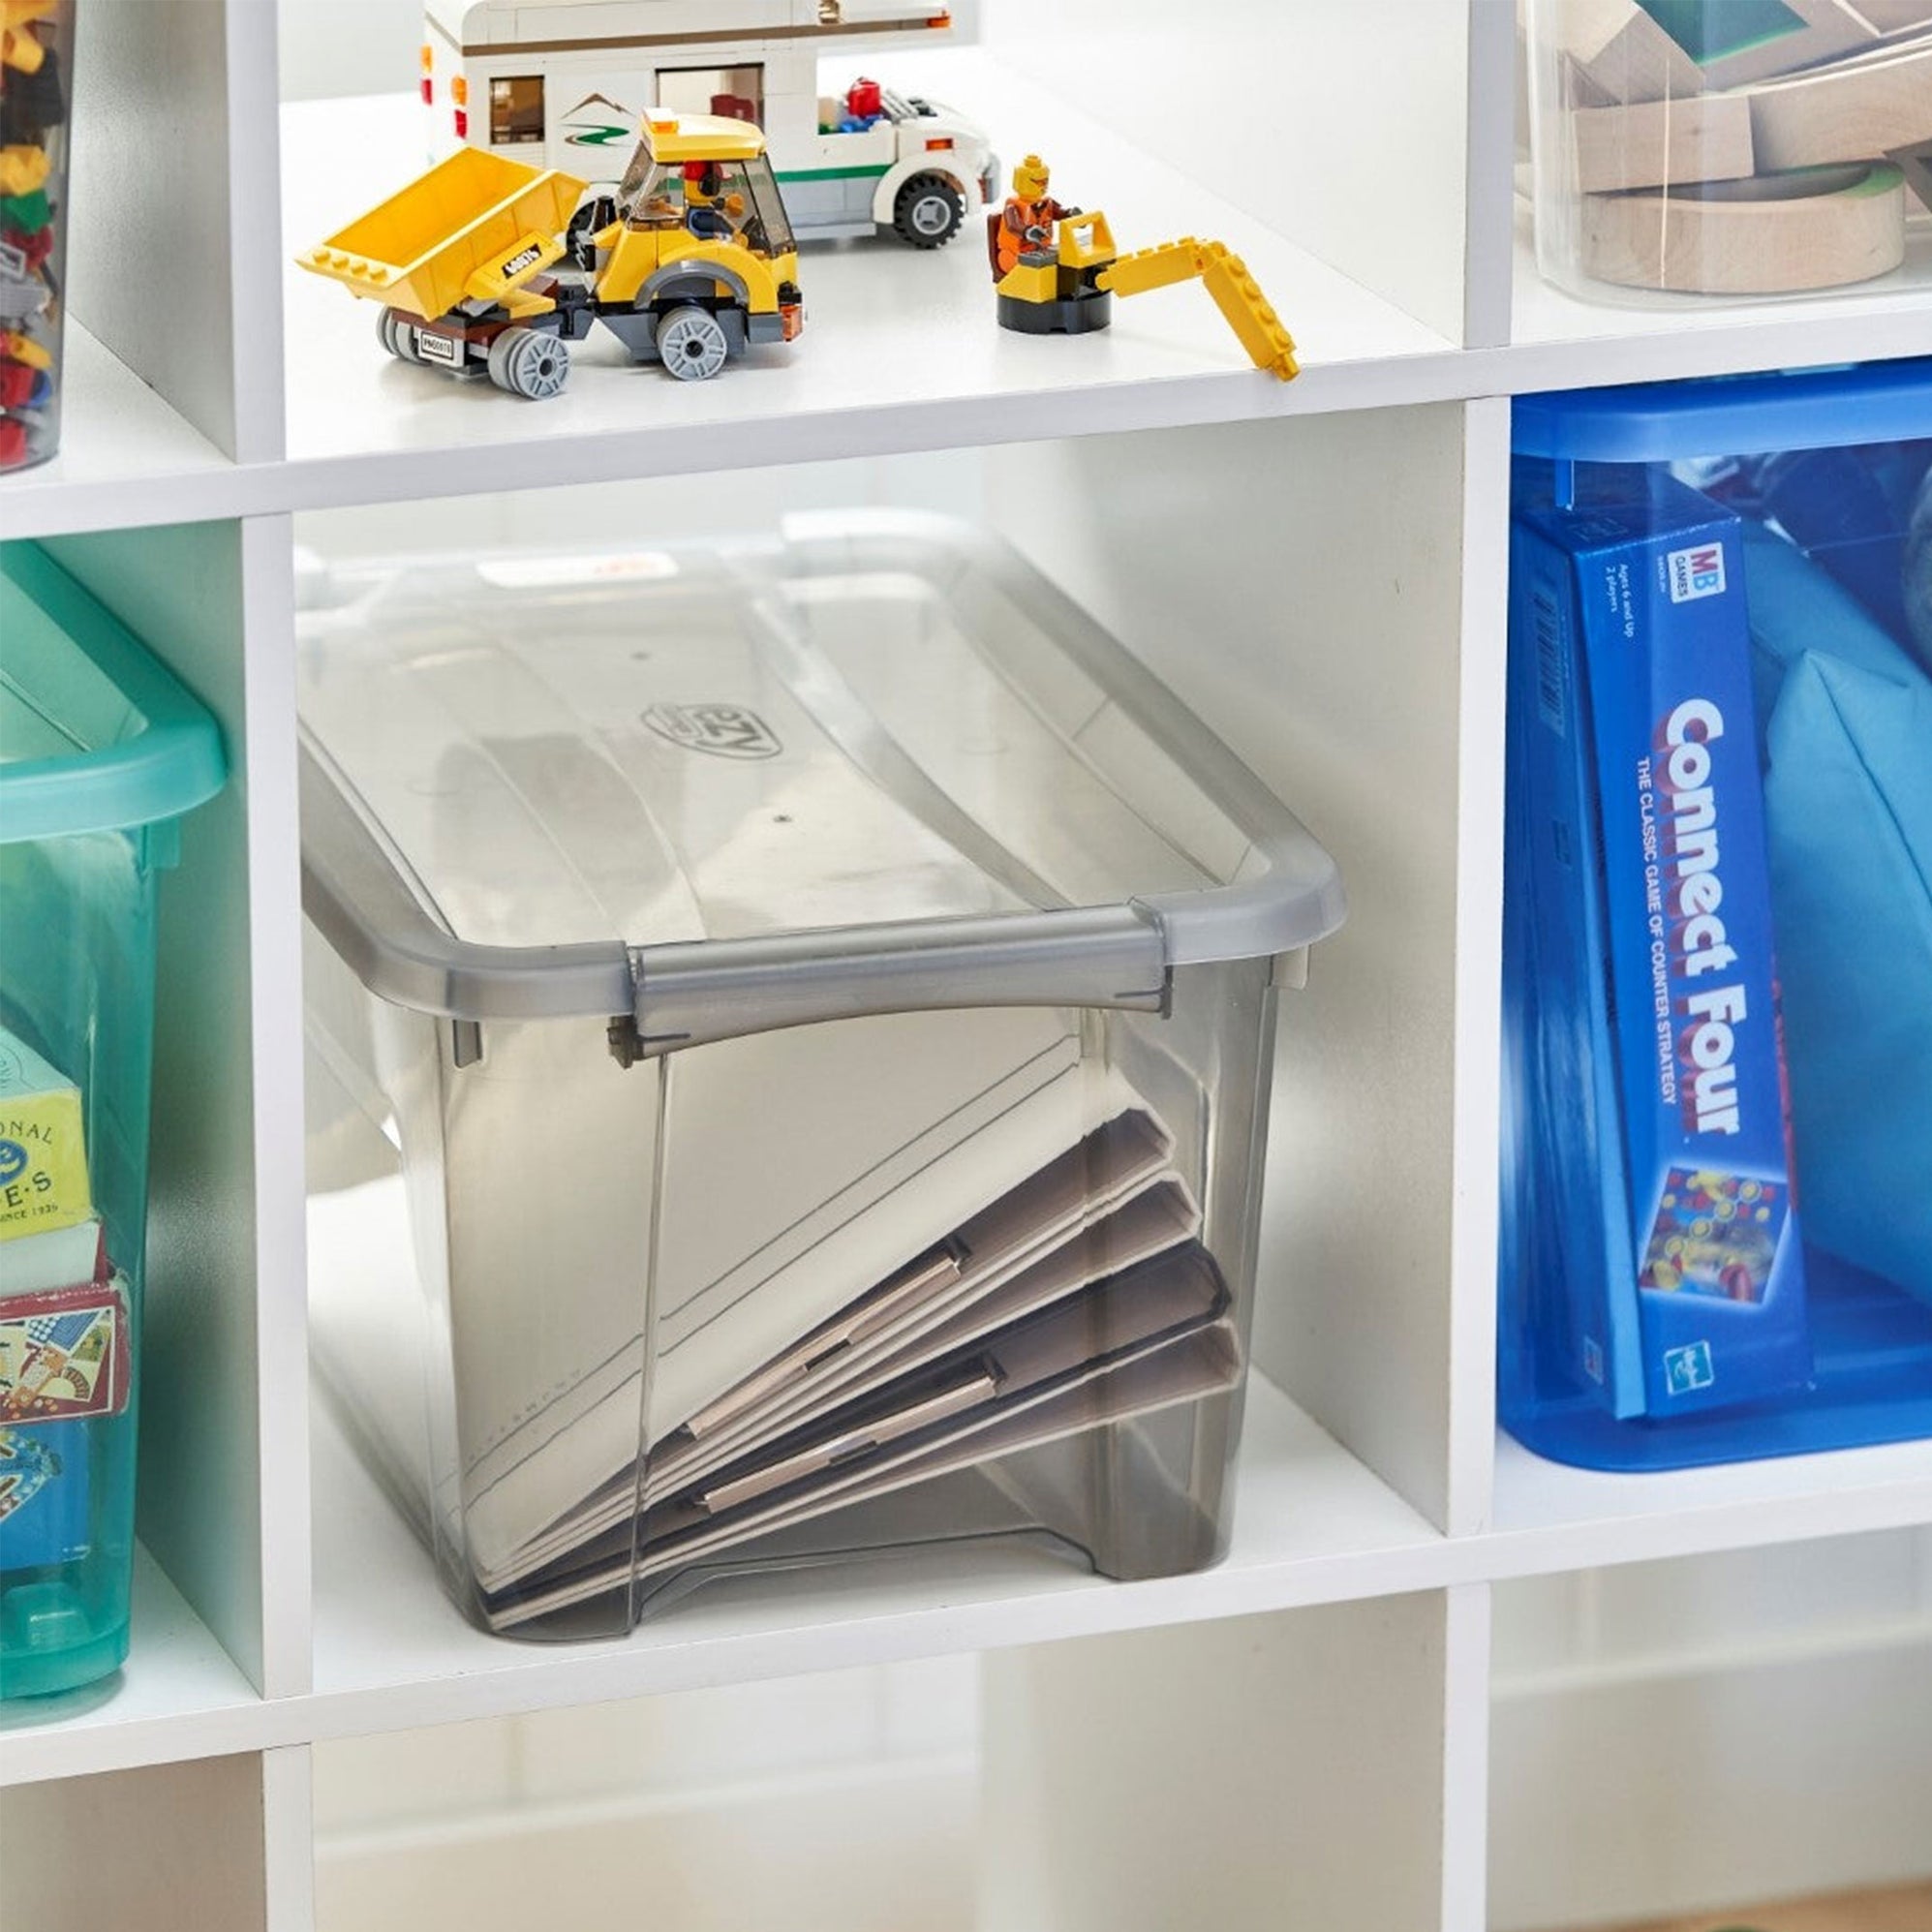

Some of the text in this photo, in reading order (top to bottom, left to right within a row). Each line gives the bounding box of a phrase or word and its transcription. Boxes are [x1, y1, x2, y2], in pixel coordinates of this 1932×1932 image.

[1618, 564, 1629, 590] Ages
[1675, 555, 1689, 598] GAMES
[1690, 549, 1719, 591] MB
[1606, 575, 1618, 613] players
[1623, 599, 1634, 621] and
[1623, 621, 1635, 638] Up
[1637, 755, 1676, 1105] THE CLASSIC GAME OF COUNTER STRATEGY
[1666, 697, 1747, 1136] Connect Four
